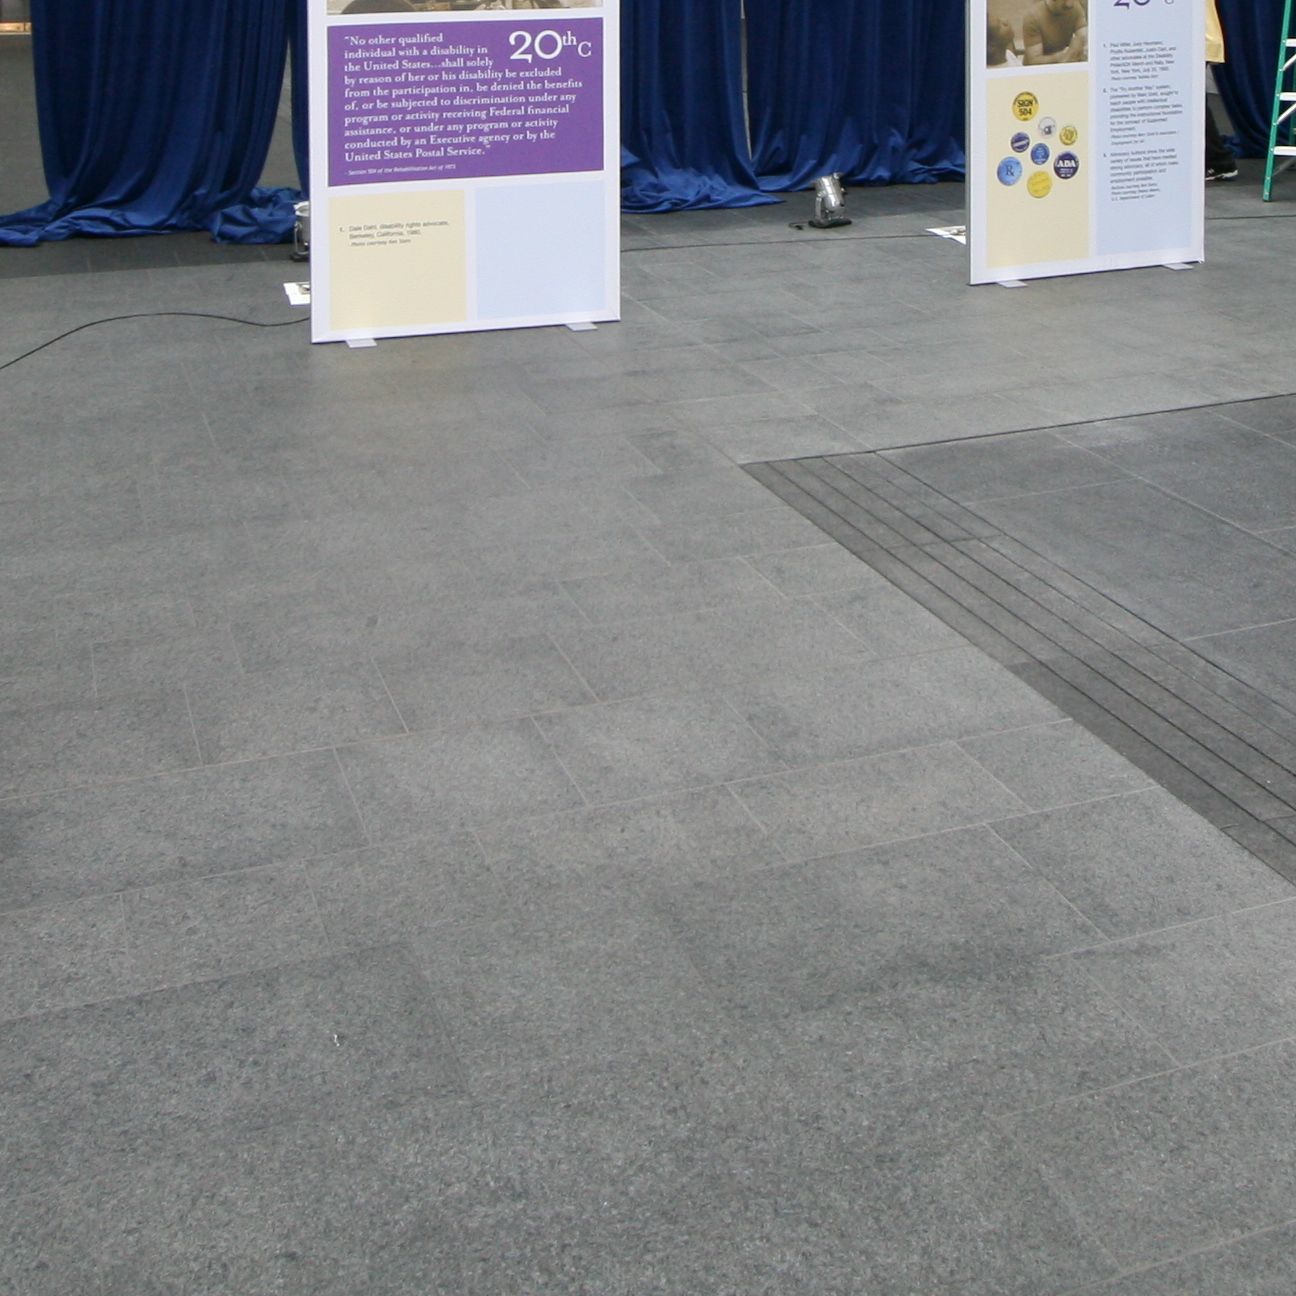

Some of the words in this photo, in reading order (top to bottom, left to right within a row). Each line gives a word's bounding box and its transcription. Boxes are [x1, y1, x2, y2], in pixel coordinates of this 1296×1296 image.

[367, 34, 397, 45] other
[397, 32, 444, 47] qualified
[343, 46, 396, 59] individual
[397, 45, 420, 56] with
[429, 44, 475, 57] disability
[476, 44, 488, 54] in
[344, 61, 361, 72] the
[363, 59, 400, 71] United
[466, 56, 494, 69] solely
[343, 74, 357, 88] by
[358, 75, 392, 84] reason
[394, 71, 407, 82] of
[407, 71, 426, 82] her
[426, 73, 440, 81] or
[441, 70, 457, 81] his
[458, 68, 503, 81] disability
[504, 68, 517, 78] be
[518, 66, 562, 78] excluded
[344, 87, 370, 98] from
[372, 86, 390, 96] the
[391, 84, 457, 99] participation
[475, 81, 489, 92] be
[489, 80, 524, 91] denied
[526, 79, 542, 90] the
[543, 78, 583, 89] benefits
[361, 102, 375, 110] or
[376, 98, 389, 109] be
[390, 96, 438, 111] subjected
[439, 98, 451, 106] to
[452, 94, 526, 106] discrimination
[527, 91, 558, 102] under
[559, 94, 577, 103] any
[344, 114, 389, 127] program
[390, 113, 403, 121] or
[404, 110, 440, 122] activity
[442, 108, 487, 120] receiving
[489, 105, 525, 117] Federal
[527, 103, 569, 115] financial
[1018, 107, 1032, 116] 504
[413, 121, 445, 133] under
[446, 123, 464, 133] any
[465, 121, 509, 133] program
[524, 117, 558, 129] activity
[344, 136, 398, 150] conducted
[399, 135, 412, 149] by
[429, 134, 476, 145] Executive
[478, 134, 511, 145] agency
[512, 133, 524, 141] or
[526, 129, 538, 142] by
[539, 129, 556, 139] the
[344, 149, 381, 162] United
[383, 149, 413, 159] States
[415, 146, 444, 158] Postal
[1056, 159, 1076, 168] ADA
